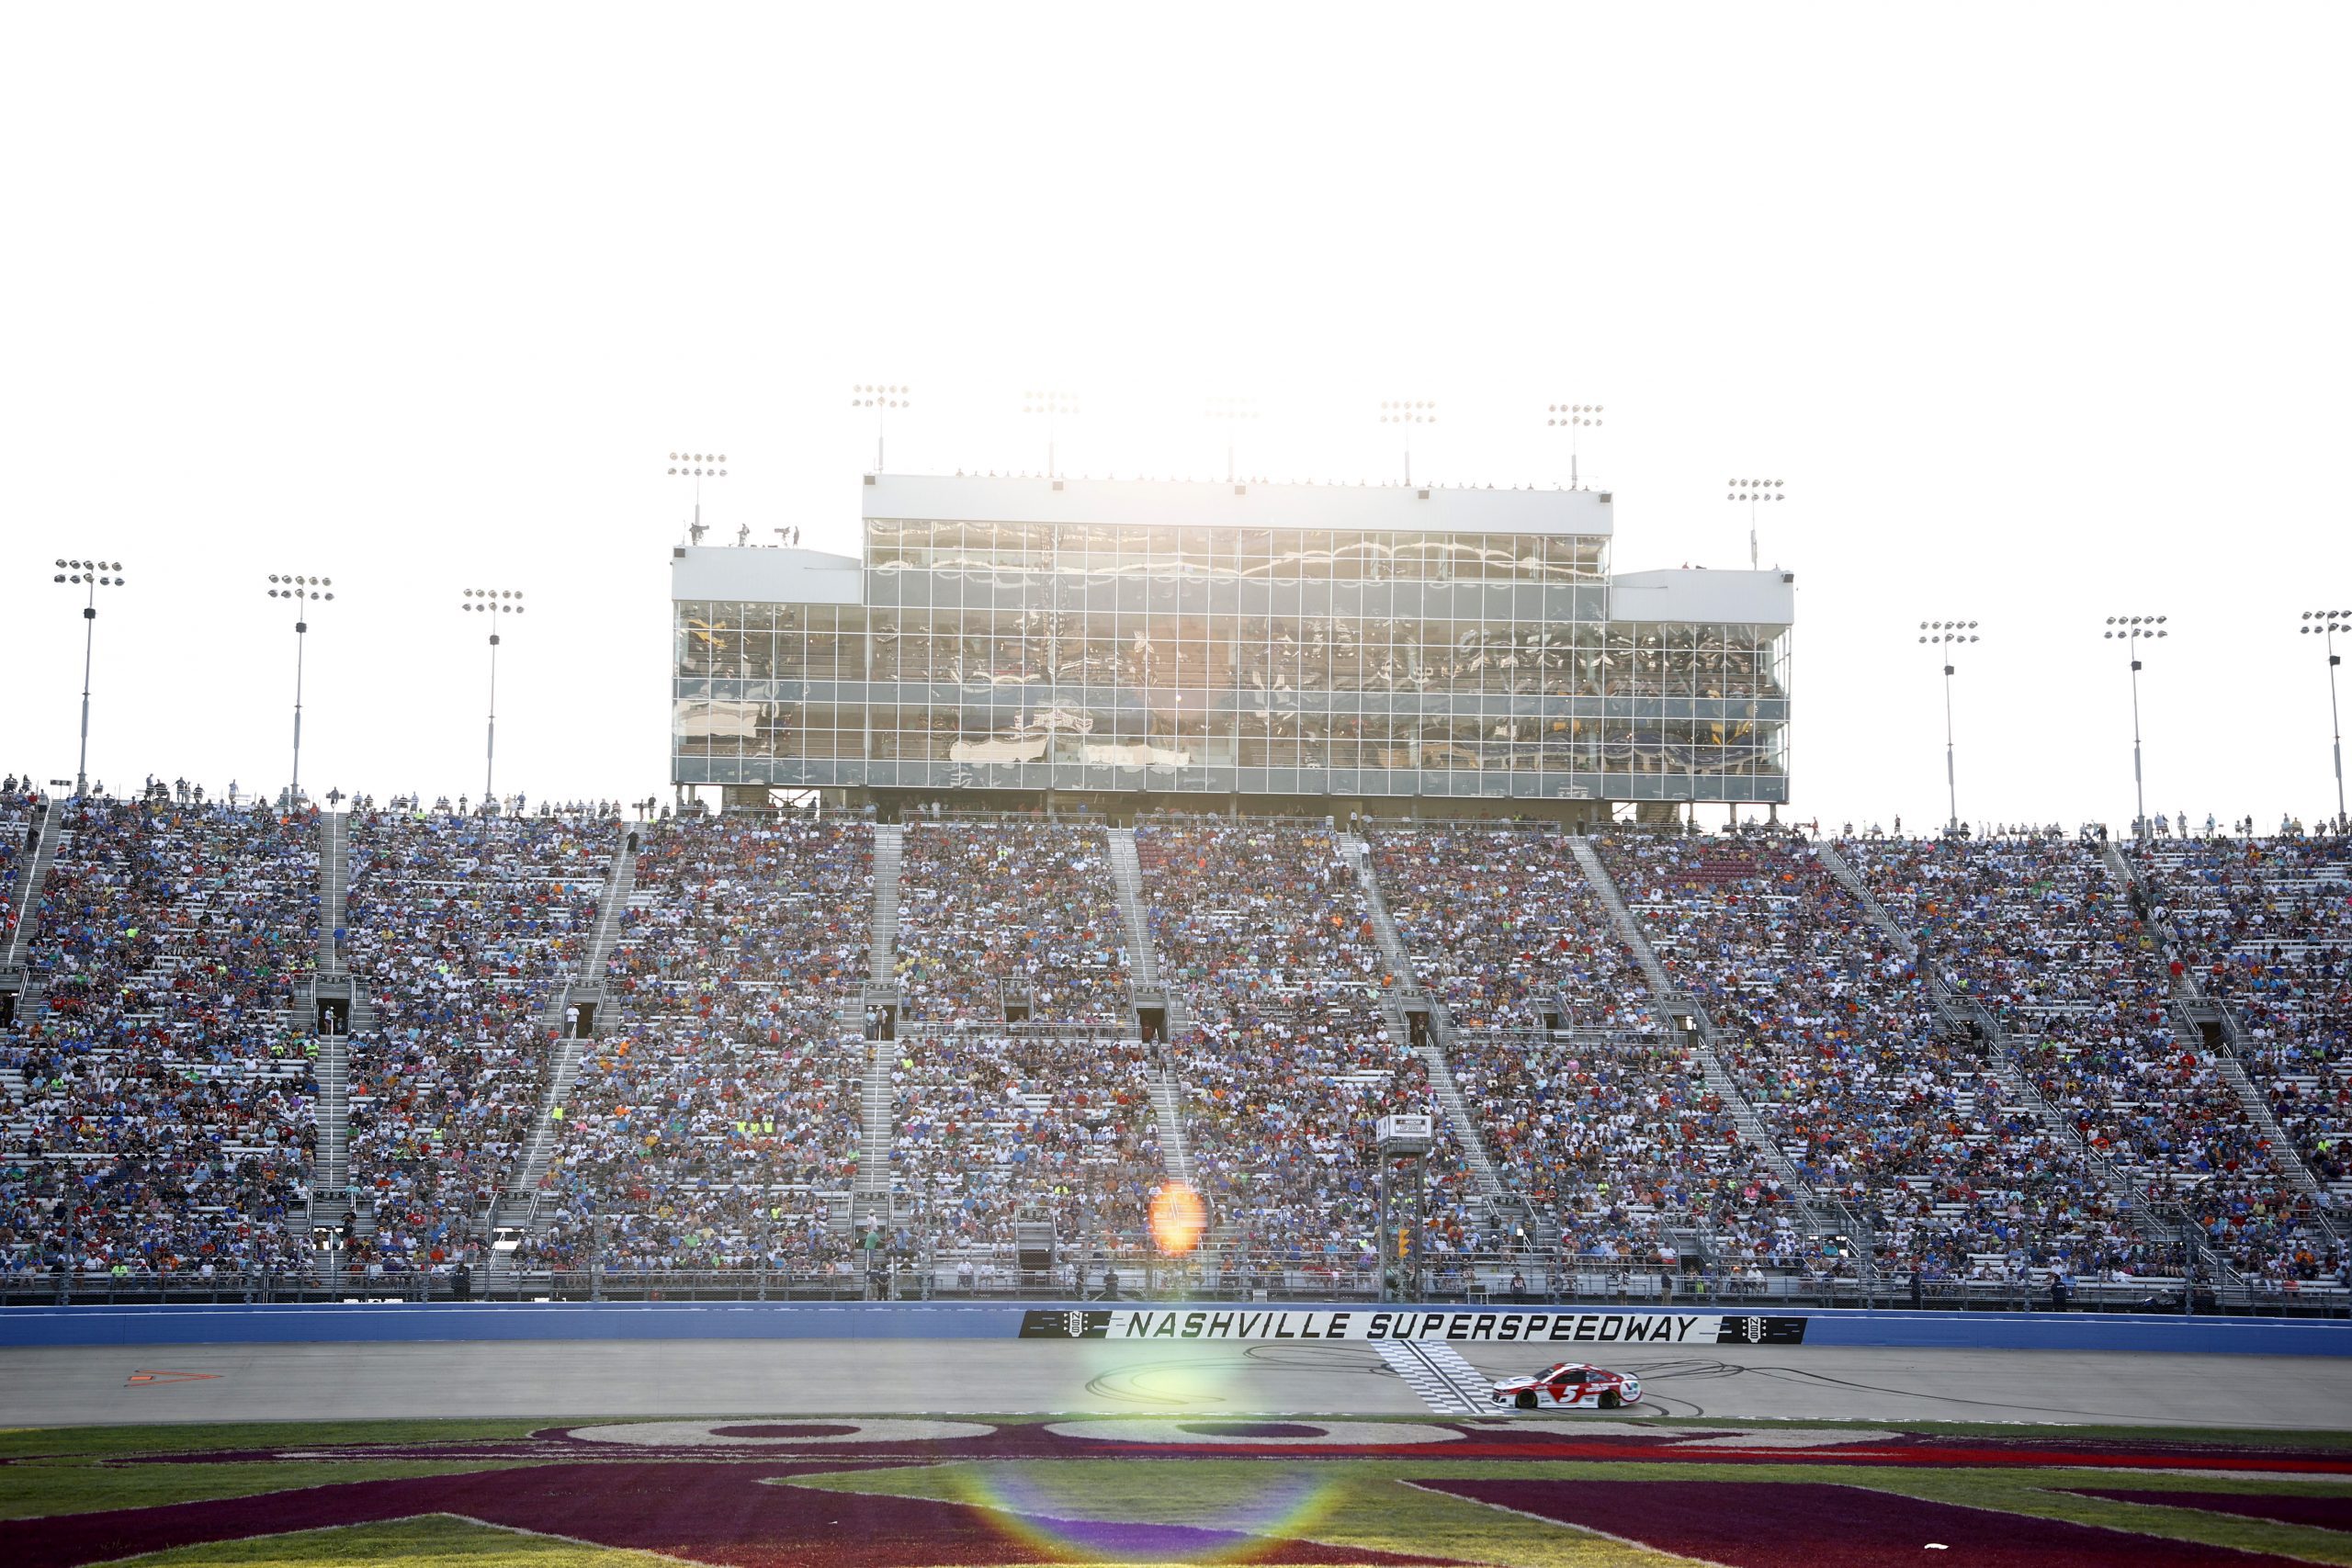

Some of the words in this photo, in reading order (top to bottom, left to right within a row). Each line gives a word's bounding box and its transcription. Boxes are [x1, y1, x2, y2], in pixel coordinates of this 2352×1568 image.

[1125, 1312, 1351, 1338] NASHVILLE
[1366, 1313, 1699, 1342] SUPERSPEEDWAY
[1558, 1384, 1580, 1404] 5
